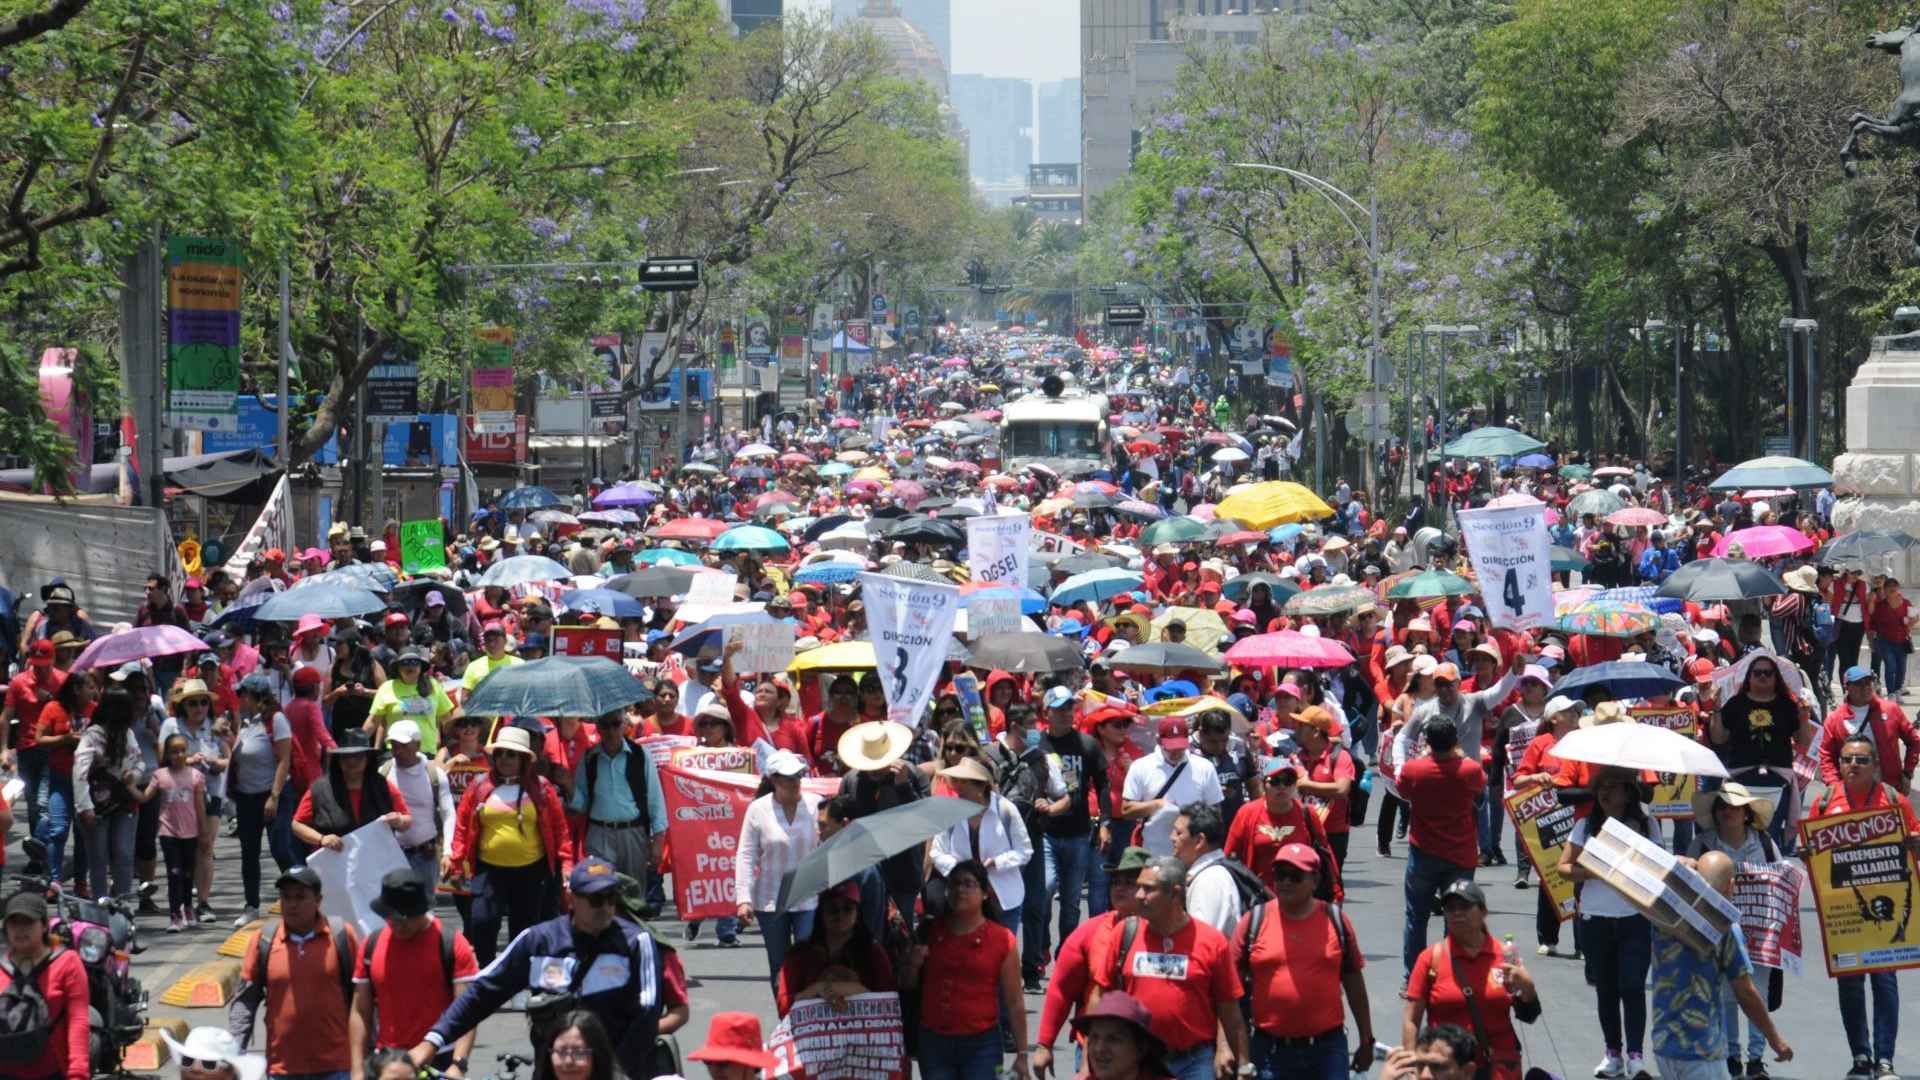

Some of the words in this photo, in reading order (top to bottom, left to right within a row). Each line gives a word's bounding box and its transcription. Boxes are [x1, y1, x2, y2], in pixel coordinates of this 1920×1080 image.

[979, 552, 1019, 583] DGSEI
[1503, 567, 1526, 617] 4
[707, 832, 736, 849] de
[1832, 845, 1900, 864] INCREMENTO
[1850, 859, 1903, 875] SALARIAL
